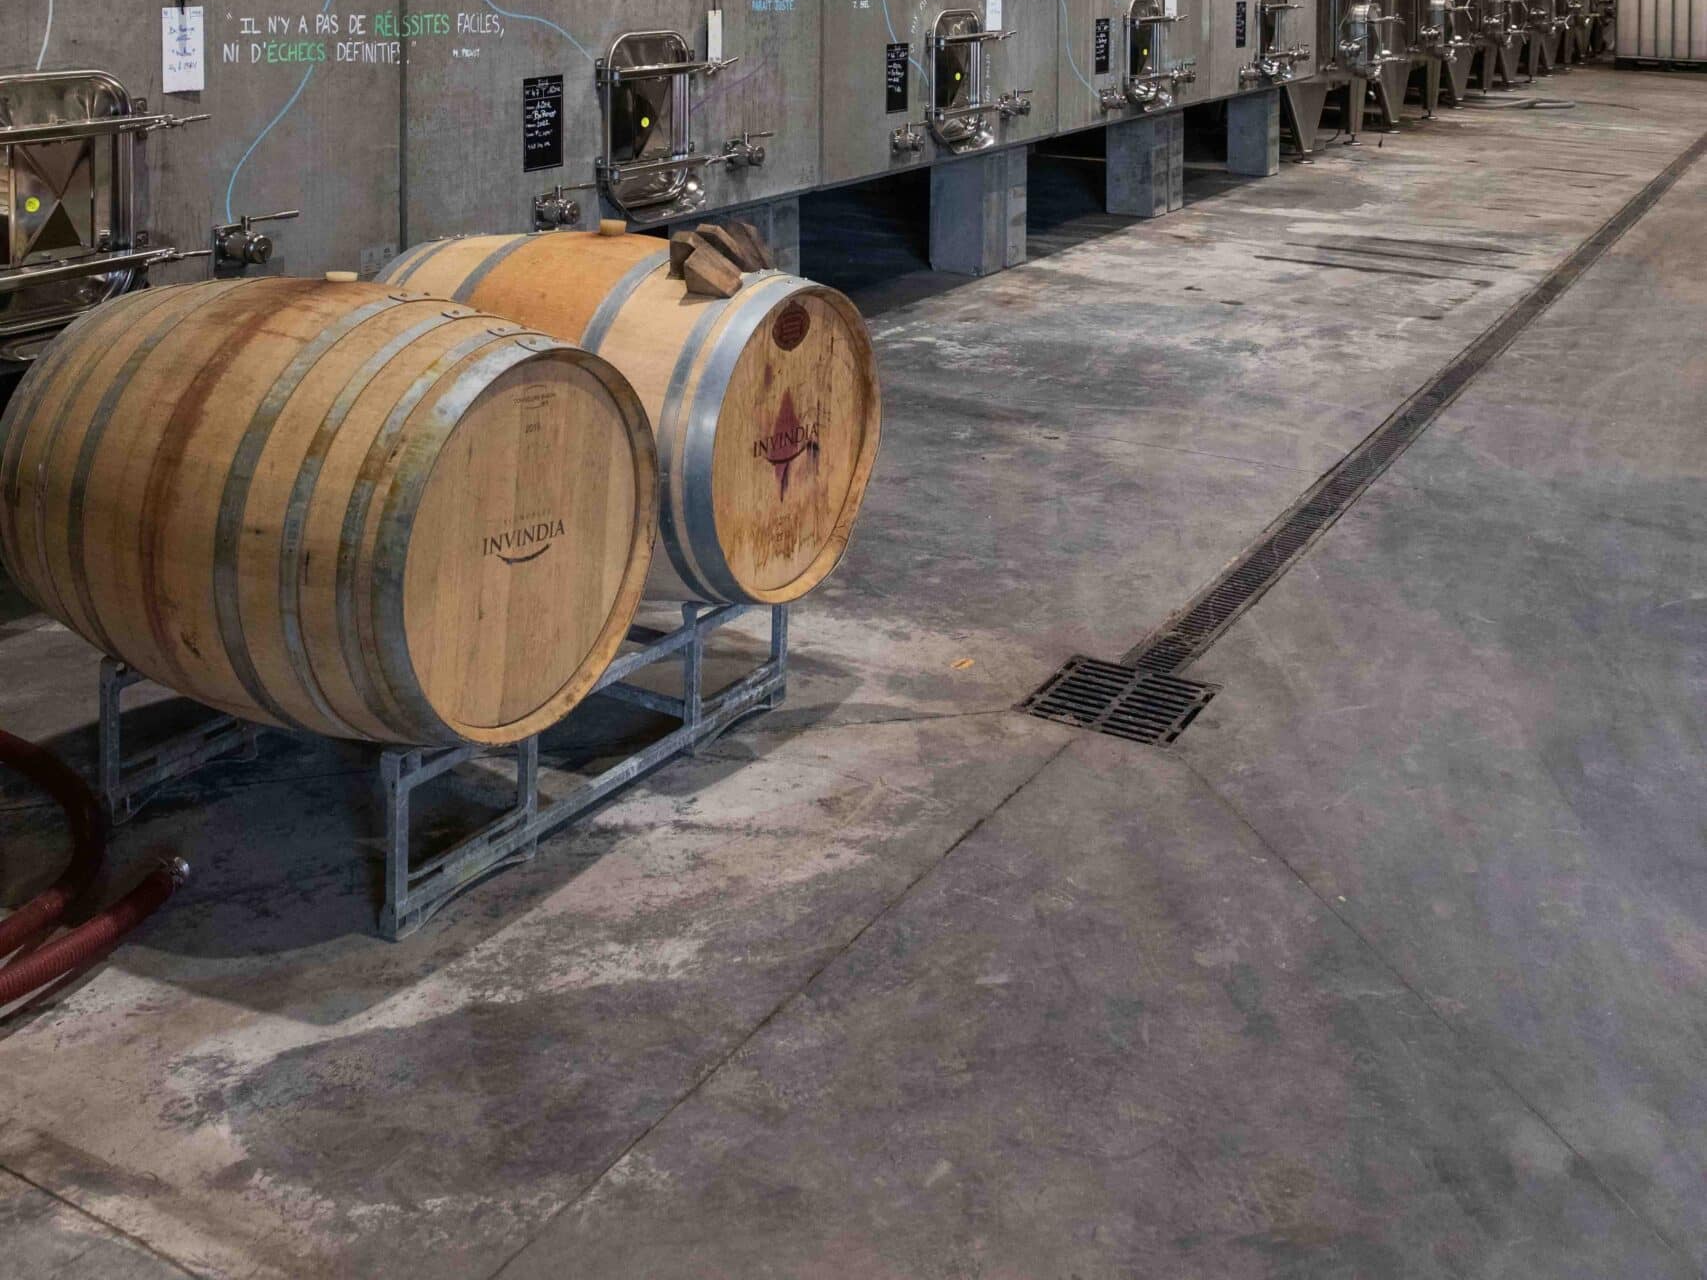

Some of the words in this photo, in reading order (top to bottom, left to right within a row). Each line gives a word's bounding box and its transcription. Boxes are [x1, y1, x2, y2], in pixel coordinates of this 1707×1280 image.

[268, 15, 290, 35] N'Y
[299, 14, 308, 35] A
[316, 14, 339, 34] PAS
[349, 16, 366, 35] DE
[374, 9, 450, 39] RÉUSSITES
[223, 40, 240, 63] NI
[251, 39, 326, 63] D'ÉCHECS
[753, 423, 819, 458] INVINDIA
[483, 519, 565, 556] INVINDIA
